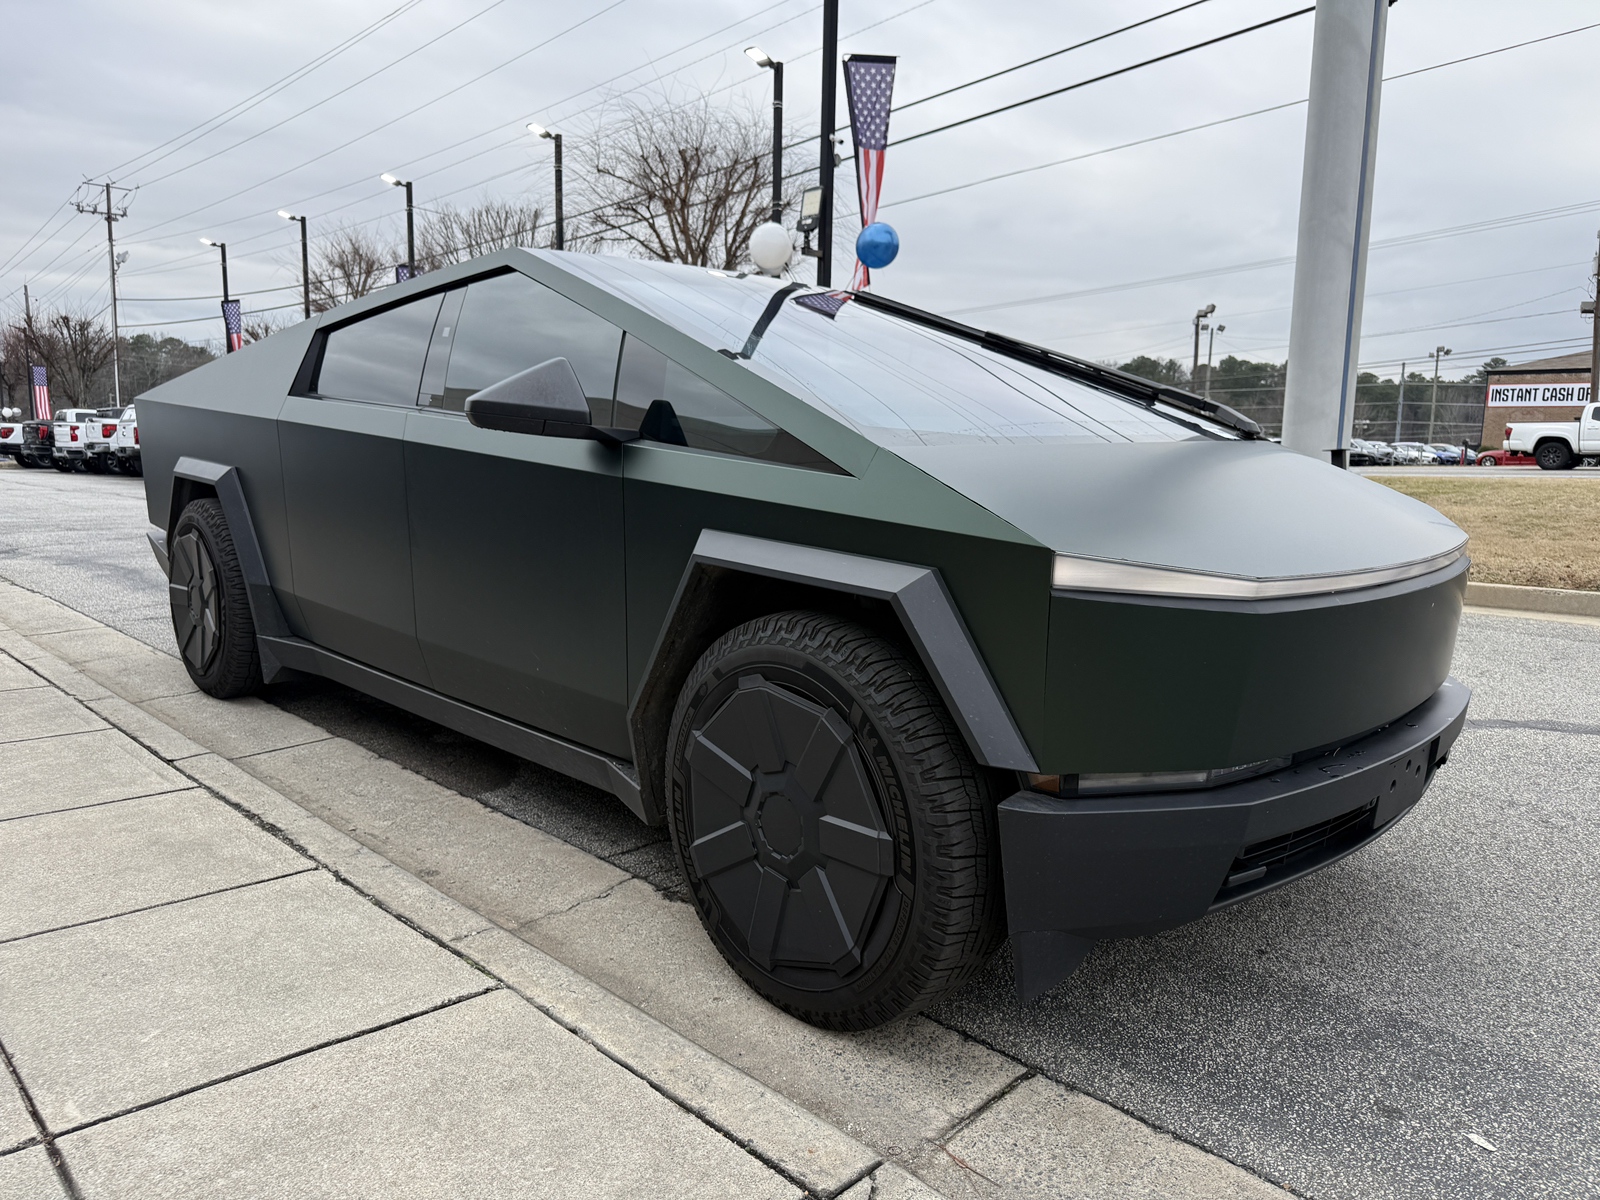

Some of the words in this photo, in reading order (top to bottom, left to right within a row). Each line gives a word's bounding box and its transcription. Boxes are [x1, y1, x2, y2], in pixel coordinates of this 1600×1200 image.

[1491, 387, 1540, 402] INSTANT
[1542, 387, 1575, 402] CASH
[674, 785, 700, 883] MICHELIN
[876, 756, 911, 875] MICHELIN
[892, 900, 909, 946] DEFENDER
